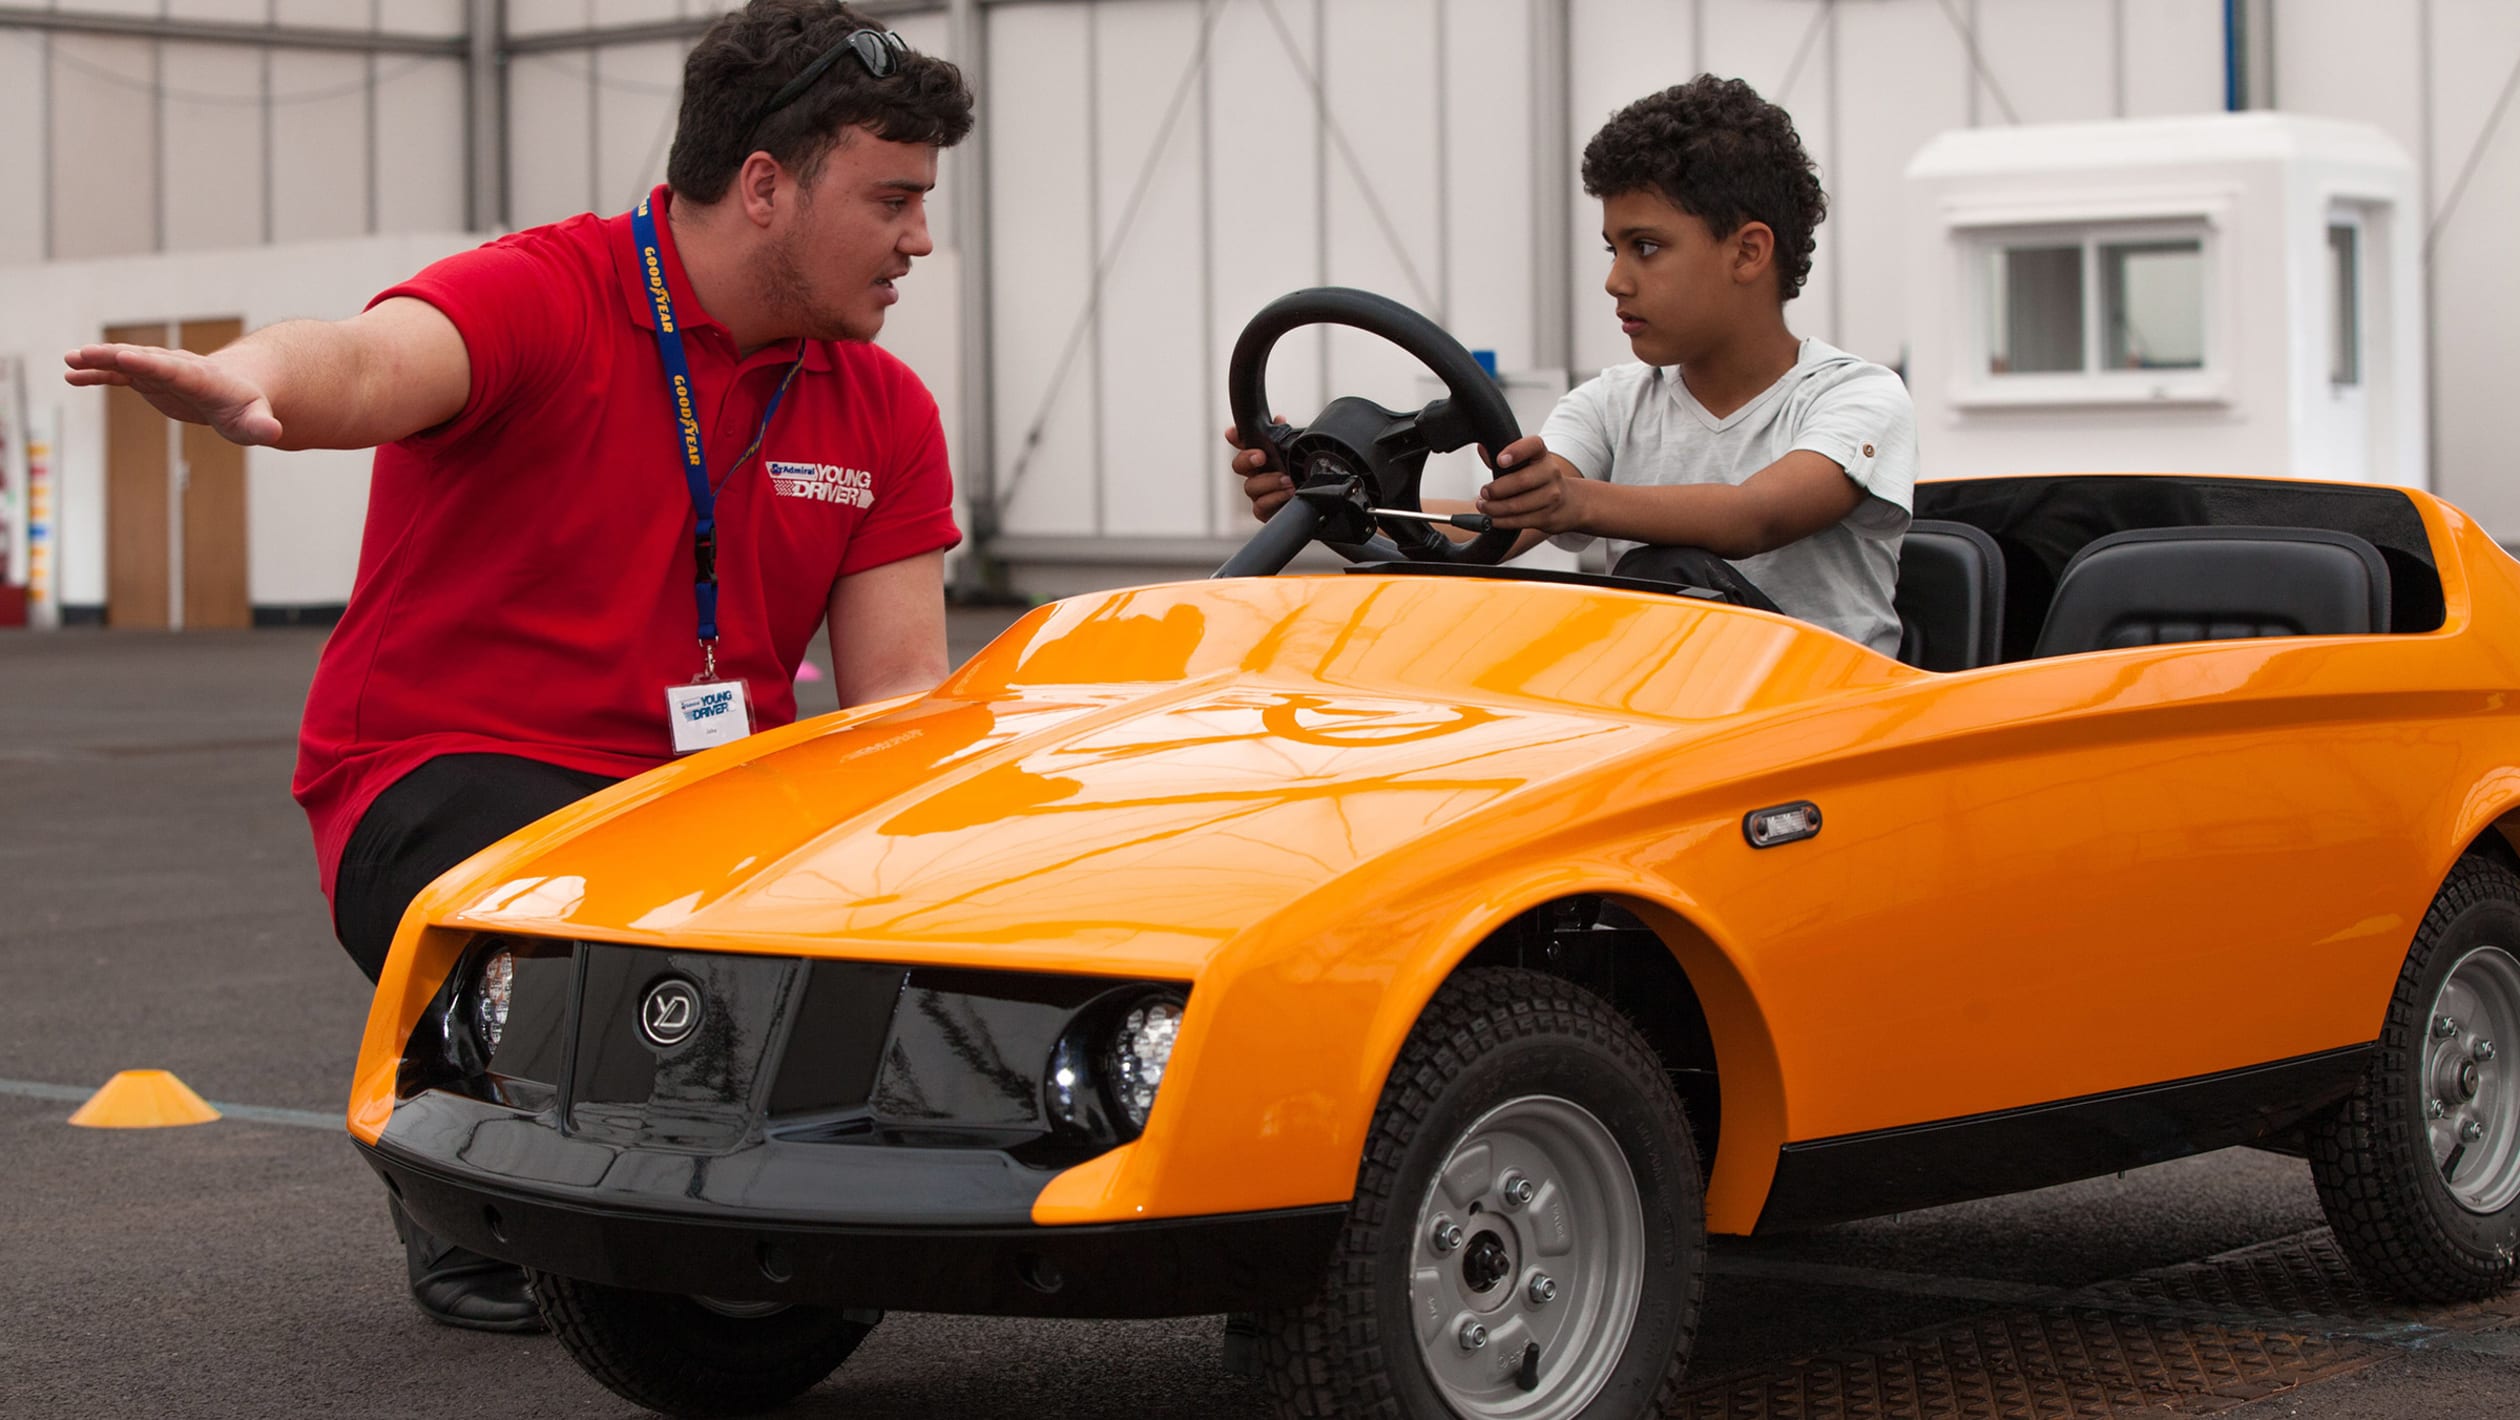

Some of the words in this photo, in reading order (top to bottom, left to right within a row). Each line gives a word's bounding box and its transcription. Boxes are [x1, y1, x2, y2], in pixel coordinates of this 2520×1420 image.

[644, 246, 674, 333] GOODYEAR
[673, 374, 700, 466] GOODYEAR
[783, 465, 815, 475] Admiral
[816, 463, 872, 489] YOUNG
[792, 480, 859, 506] DRIVER
[692, 702, 729, 720] DRIVER
[701, 690, 732, 706] YOUNG
[653, 994, 690, 1028] YD
